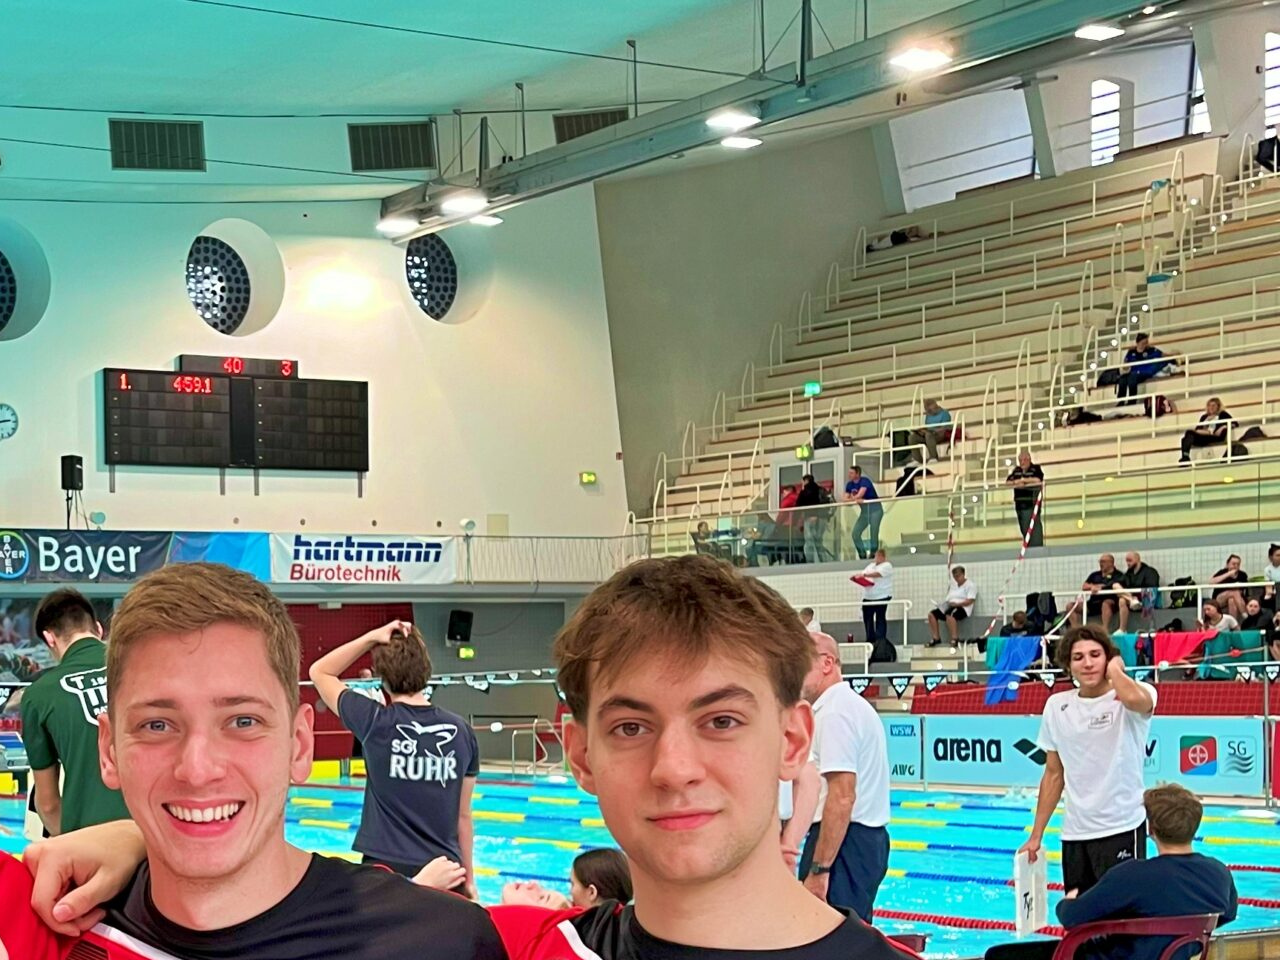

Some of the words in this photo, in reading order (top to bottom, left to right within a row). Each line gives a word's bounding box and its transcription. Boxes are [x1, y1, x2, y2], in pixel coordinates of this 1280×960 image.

[223, 358, 243, 374] 40
[281, 360, 292, 376] 3
[37, 536, 142, 580] Bayer
[293, 534, 443, 563] hartmann
[289, 563, 402, 582] Bürotechnik
[391, 738, 413, 753] SG
[933, 737, 1002, 763] arena
[1227, 740, 1247, 756] SG
[389, 754, 458, 780] RUHR
[891, 763, 915, 776] AWG
